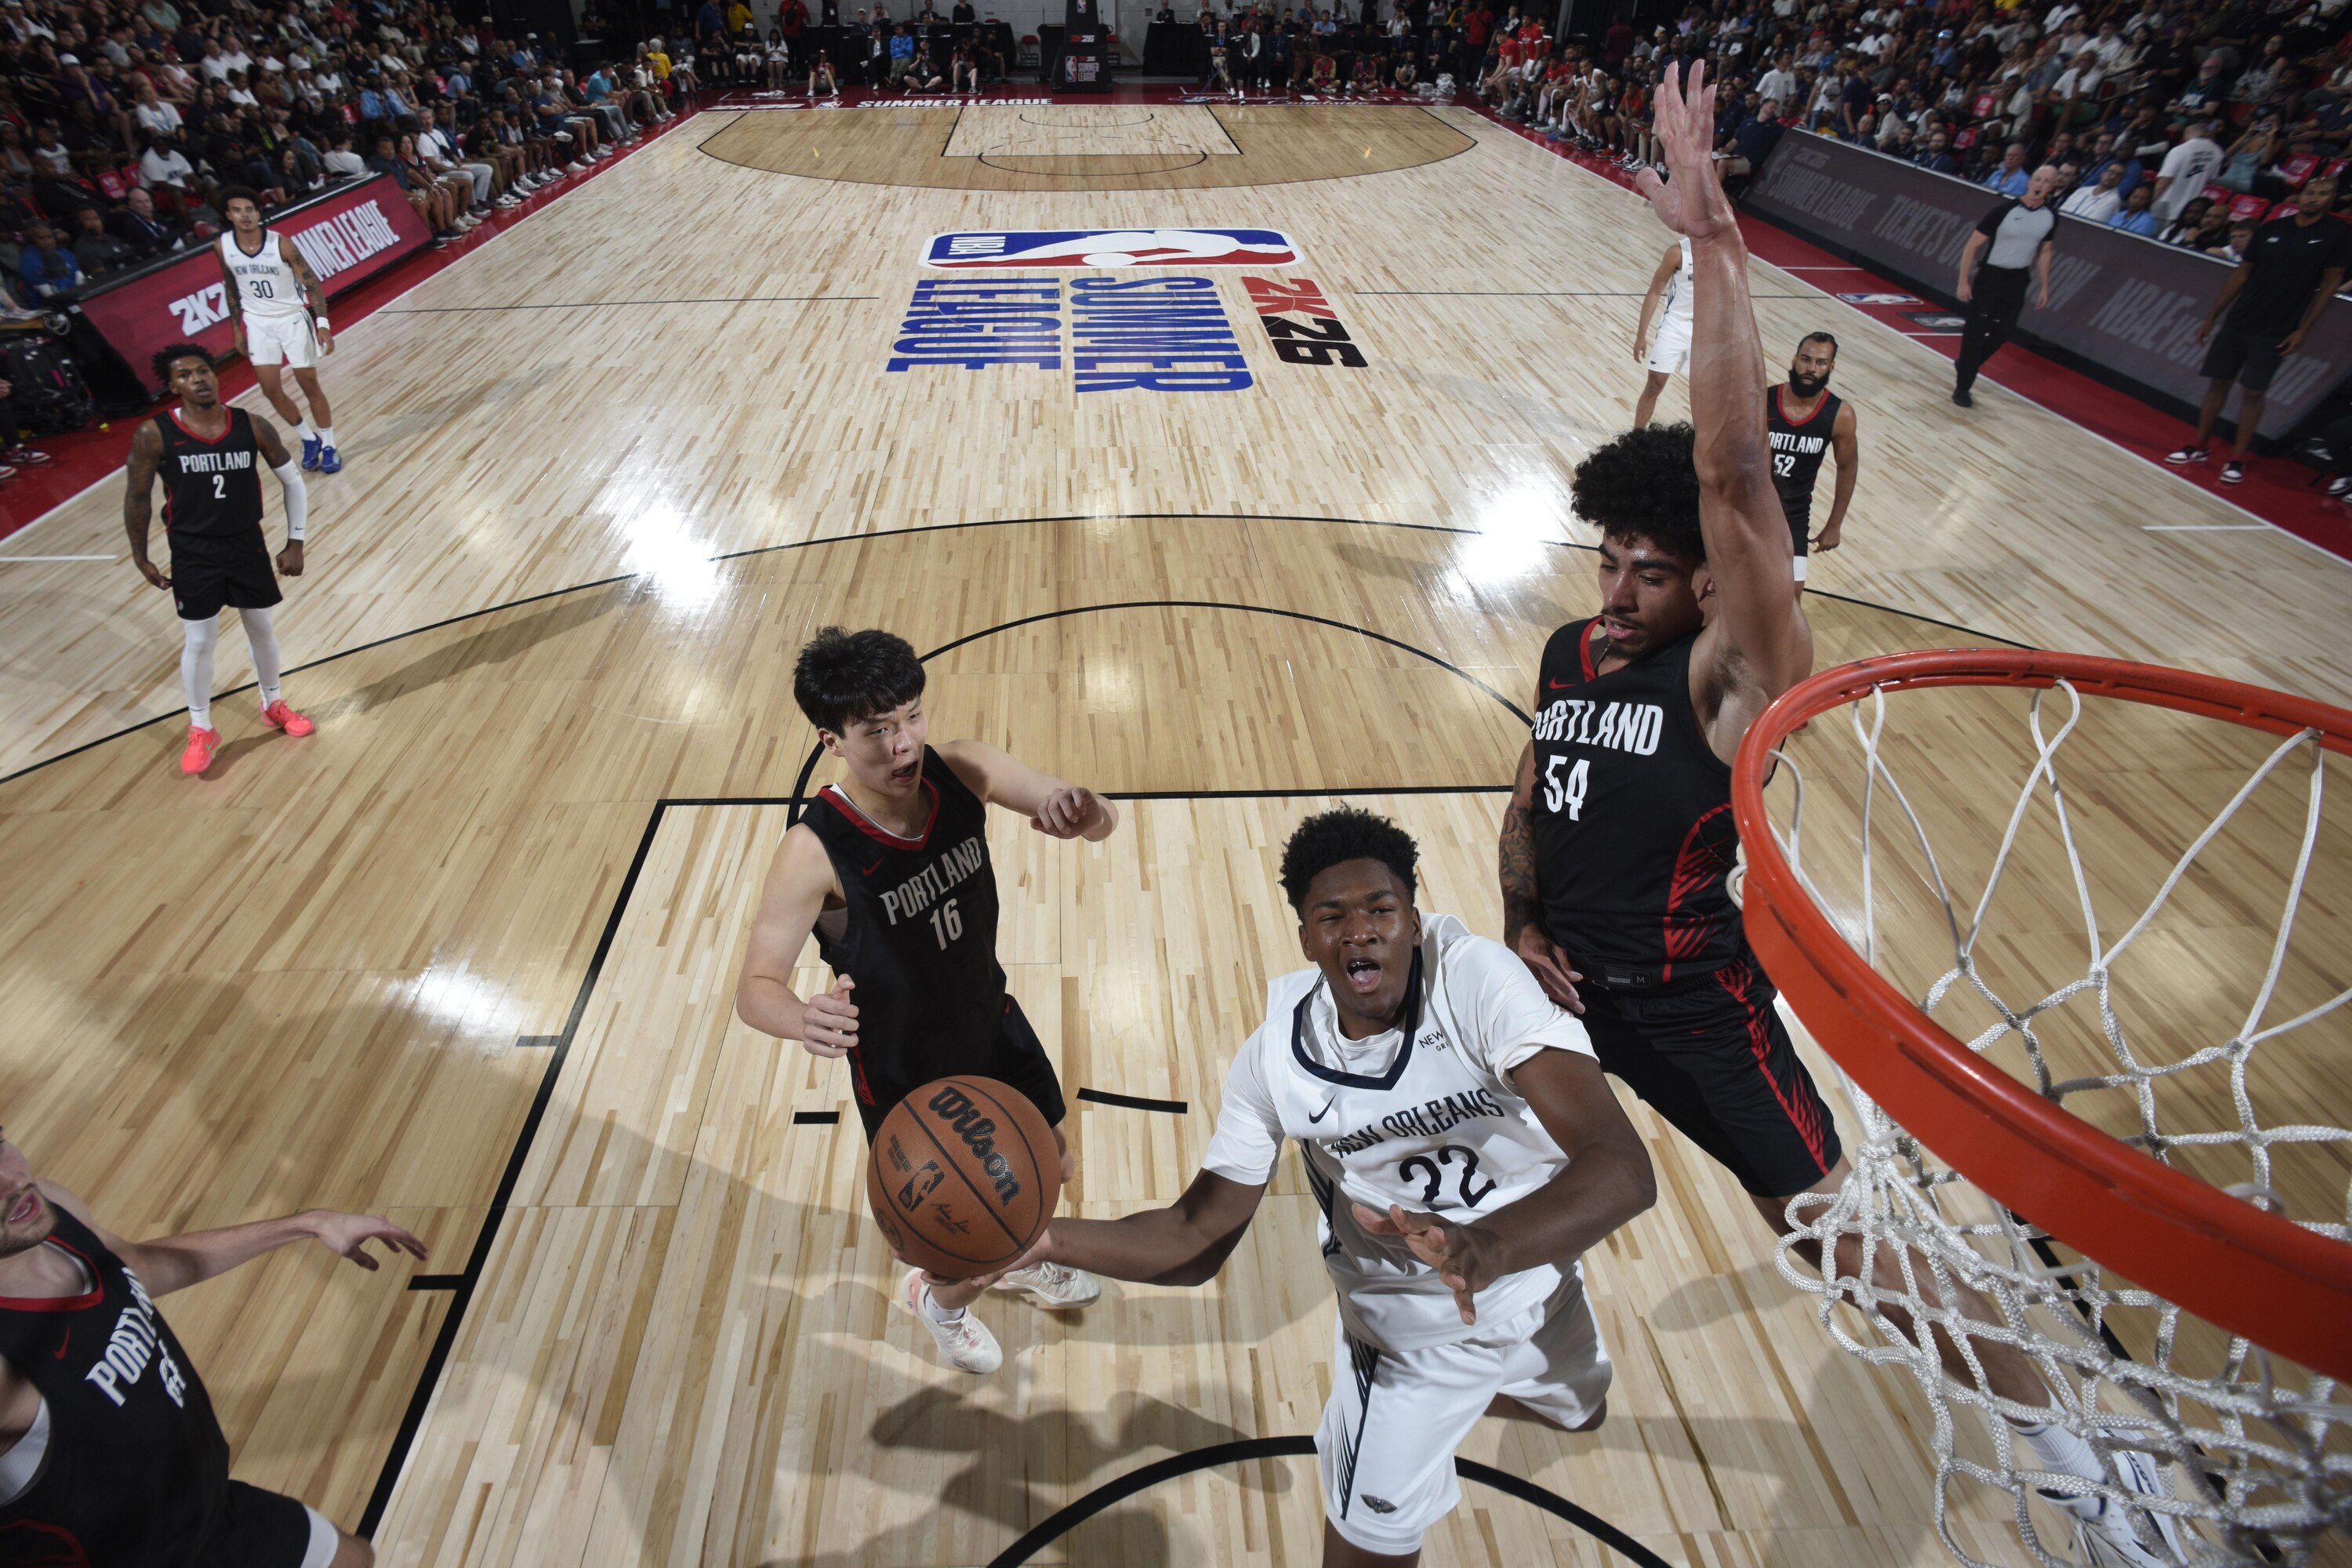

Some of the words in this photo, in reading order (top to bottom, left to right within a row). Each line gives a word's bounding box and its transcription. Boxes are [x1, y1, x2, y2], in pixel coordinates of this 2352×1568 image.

[856, 100, 963, 108] SUMMER
[1768, 163, 1831, 214] SUMMER
[1813, 181, 1878, 232] LEAGUE
[1871, 194, 1960, 258] TICKETS
[169, 281, 230, 336] 2K2
[290, 220, 358, 281] MMER
[332, 199, 401, 265] LEAGUE
[249, 263, 280, 276] ORLEANS
[948, 236, 1006, 256] NBA
[250, 281, 274, 299] 30
[1241, 276, 1368, 368] 2K26
[886, 278, 1062, 372] LEAGUE
[1069, 277, 1254, 393] SUMMER
[178, 451, 250, 474] PORTLAND
[1768, 431, 1824, 454] ORTLAND
[1773, 453, 1795, 477] 52
[212, 474, 227, 499] 2
[1543, 754, 1591, 822] 54
[878, 837, 982, 926] PORTLAND
[929, 898, 963, 951] 16
[928, 1085, 1020, 1207] Wilson
[1330, 1124, 1385, 1159] NEW
[1382, 1087, 1505, 1138] ORLEANS
[1399, 1144, 1497, 1212] 22
